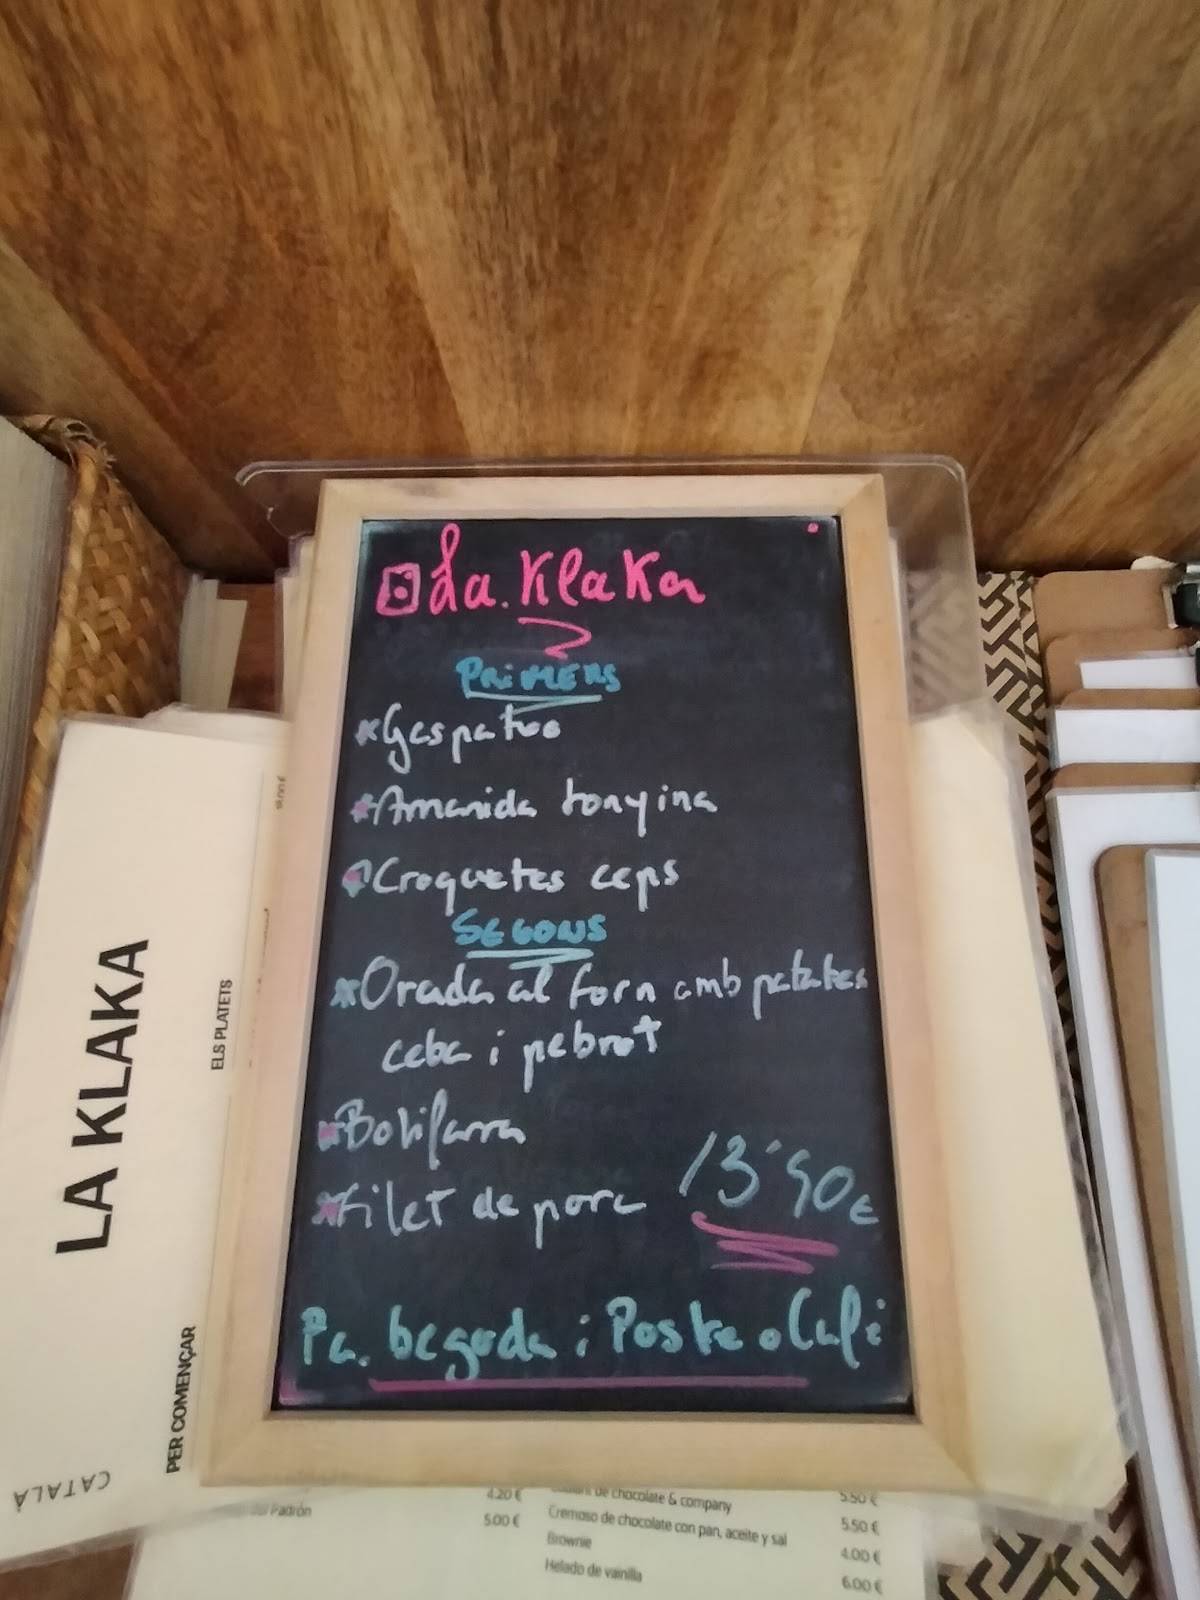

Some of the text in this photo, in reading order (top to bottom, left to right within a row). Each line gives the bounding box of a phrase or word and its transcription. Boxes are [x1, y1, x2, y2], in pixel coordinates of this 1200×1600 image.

[372, 778, 718, 837] Amanida tonyina
[372, 857, 680, 916] Croquetes ceps
[359, 956, 495, 1010] Orada
[507, 964, 555, 1003] al
[569, 962, 657, 1010] forn
[674, 957, 741, 1001] amb
[211, 979, 233, 1070] ELS PLATETS
[381, 1015, 662, 1093] ceba i pebrot
[56, 939, 149, 1254] LA KLAKA
[335, 1088, 527, 1170] Botifarra
[472, 1186, 520, 1220] de
[533, 1189, 647, 1249] porc
[576, 1313, 591, 1359] i
[166, 1325, 196, 1474] PER COMENÇAR
[512, 1513, 520, 1529] €
[548, 1504, 788, 1548] Cremoso de chocolate con pan, aceite y sal
[611, 1487, 665, 1505] chocolate
[667, 1492, 677, 1506] &
[680, 1495, 732, 1515] company
[547, 1530, 593, 1549] Brownie
[871, 1520, 880, 1536] €
[545, 1557, 585, 1577] Helado
[587, 1563, 601, 1578] de
[872, 1550, 881, 1565] €
[874, 1580, 883, 1595] €
